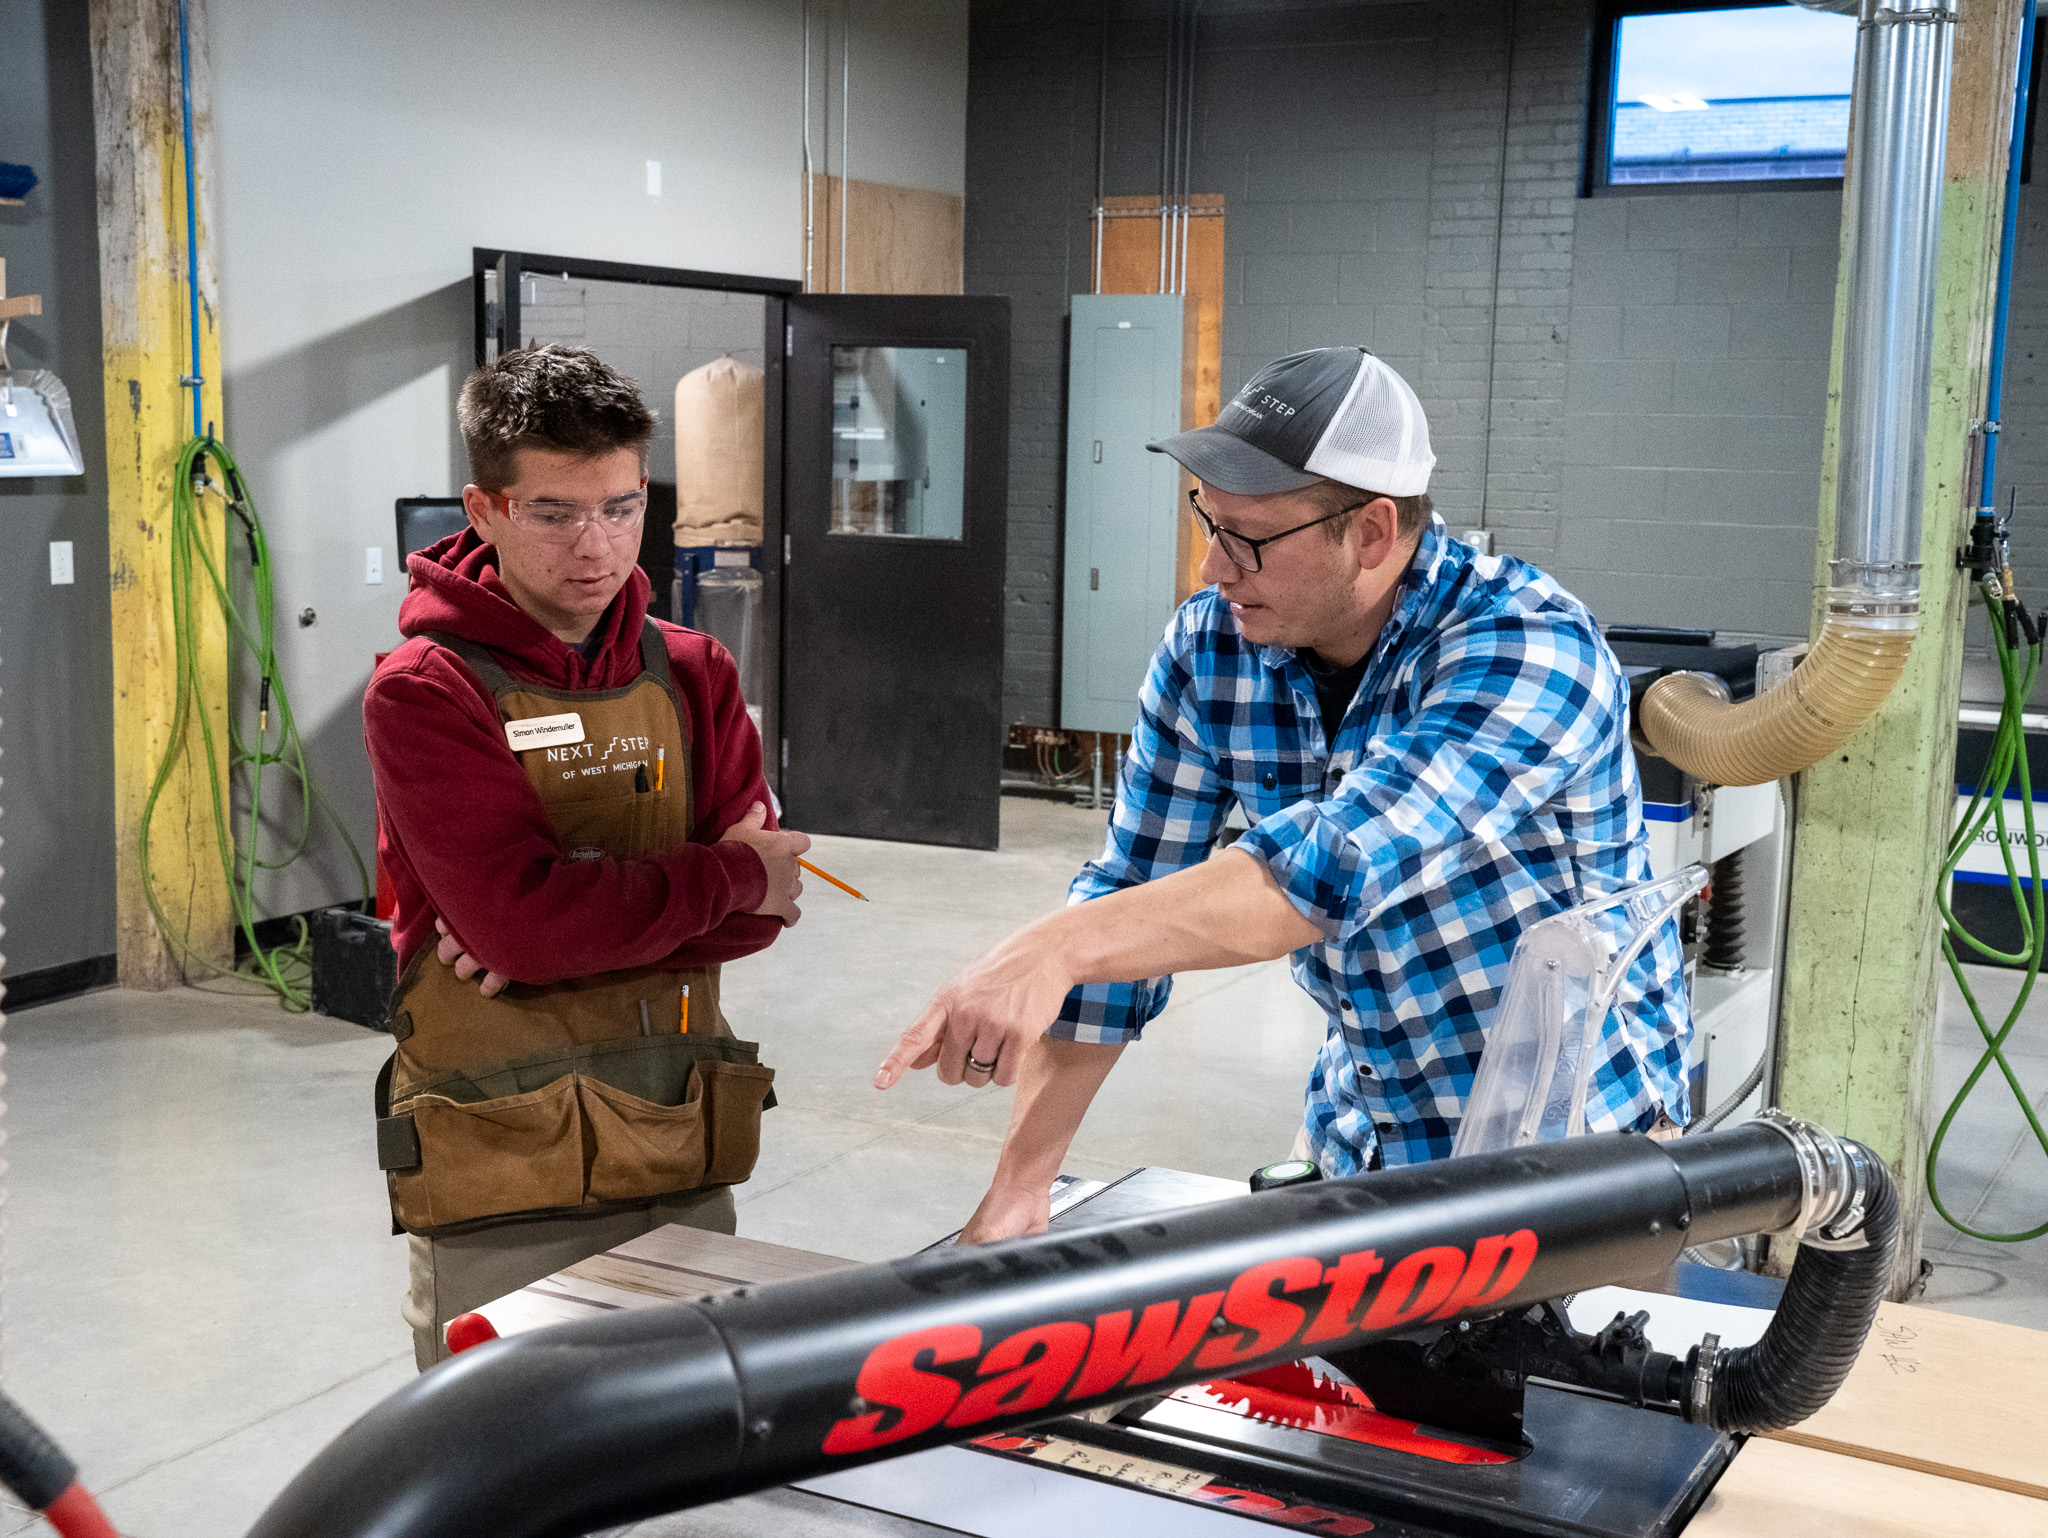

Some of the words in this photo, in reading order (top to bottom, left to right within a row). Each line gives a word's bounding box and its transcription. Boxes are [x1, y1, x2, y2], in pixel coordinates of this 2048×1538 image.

[1261, 395, 1296, 417] STEP
[512, 729, 535, 738] Simon
[547, 743, 594, 762] NEXT
[620, 736, 649, 751] STEP
[562, 770, 576, 780] OF
[581, 765, 607, 776] WEST
[822, 1229, 1539, 1455] SawStop
